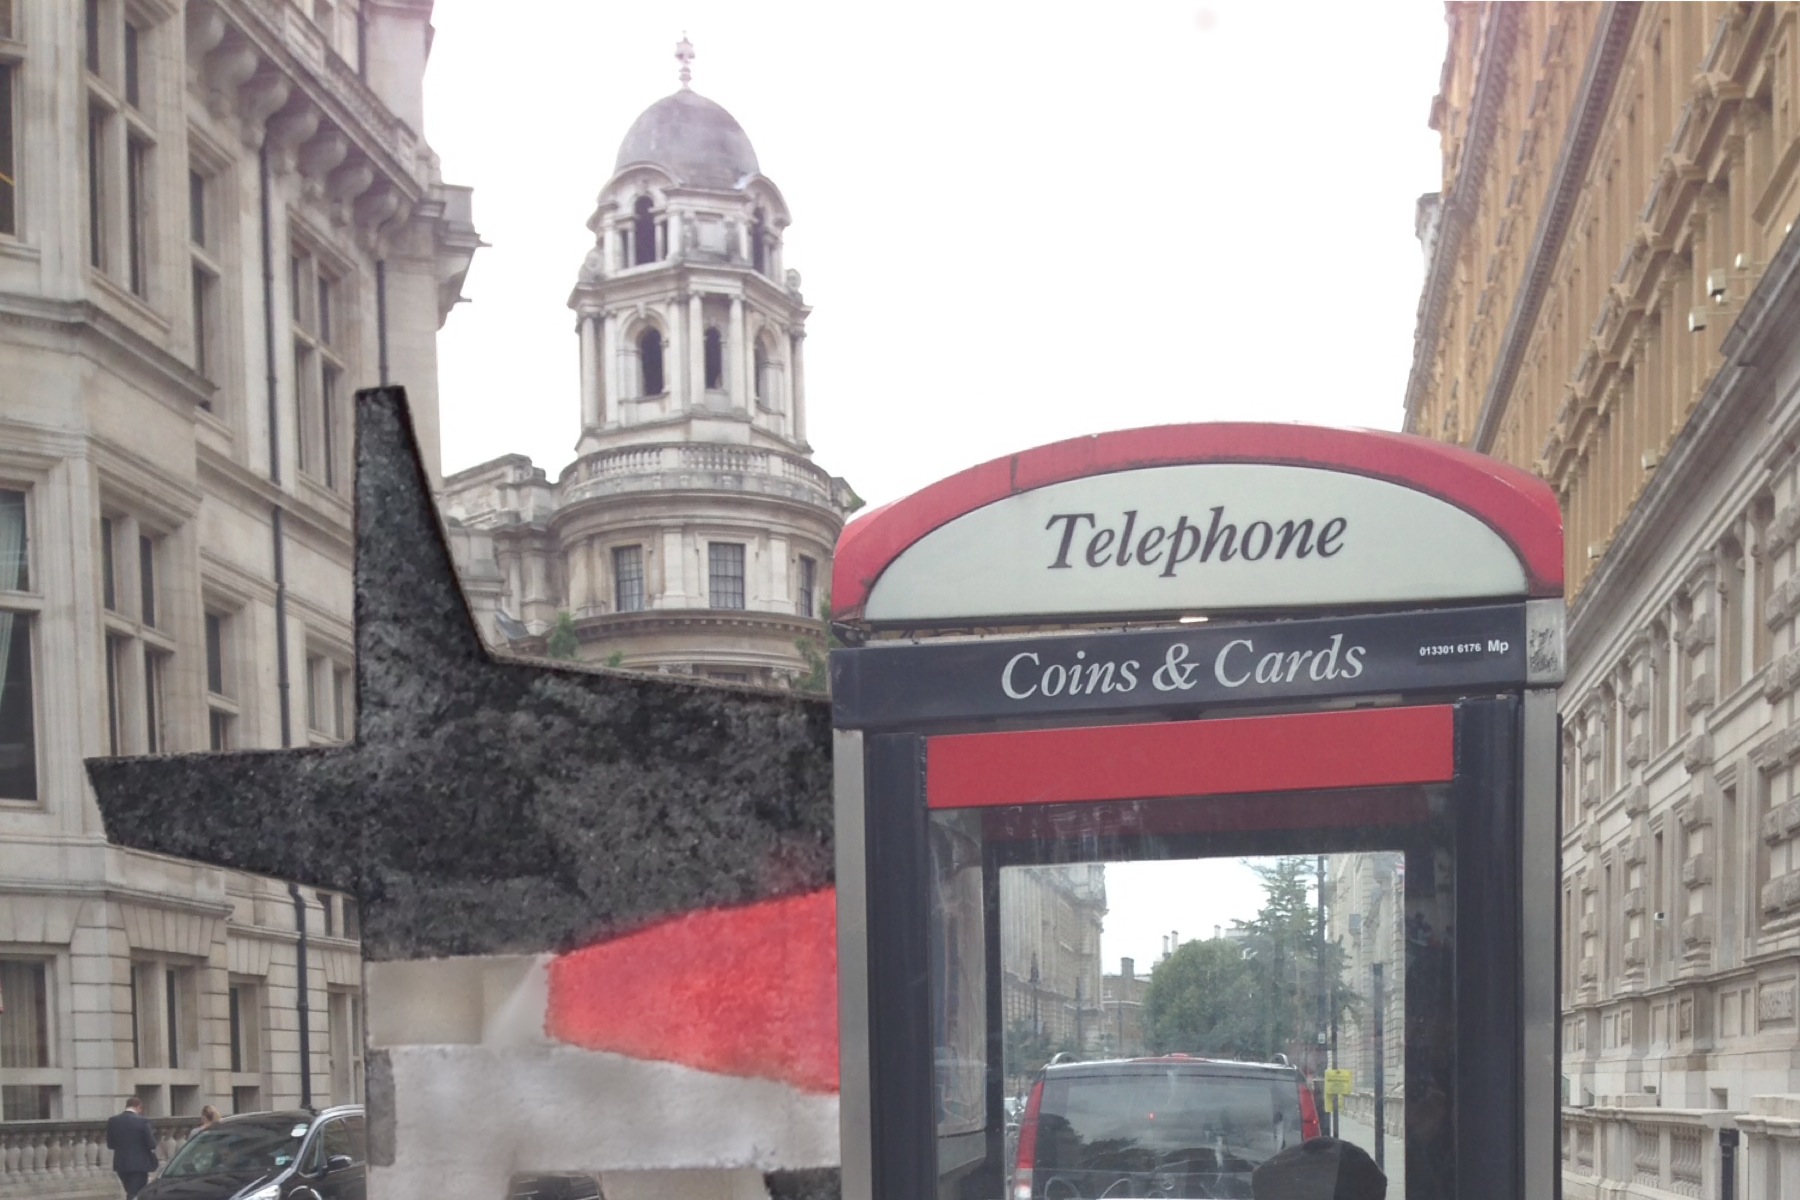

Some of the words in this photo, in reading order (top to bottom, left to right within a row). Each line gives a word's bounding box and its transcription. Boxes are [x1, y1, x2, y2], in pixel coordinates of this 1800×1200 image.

[1045, 506, 1347, 577] Telephone
[1001, 650, 1139, 699] Coins
[1152, 643, 1199, 691] &
[1214, 633, 1366, 688] Cards
[1487, 639, 1509, 653] Mp
